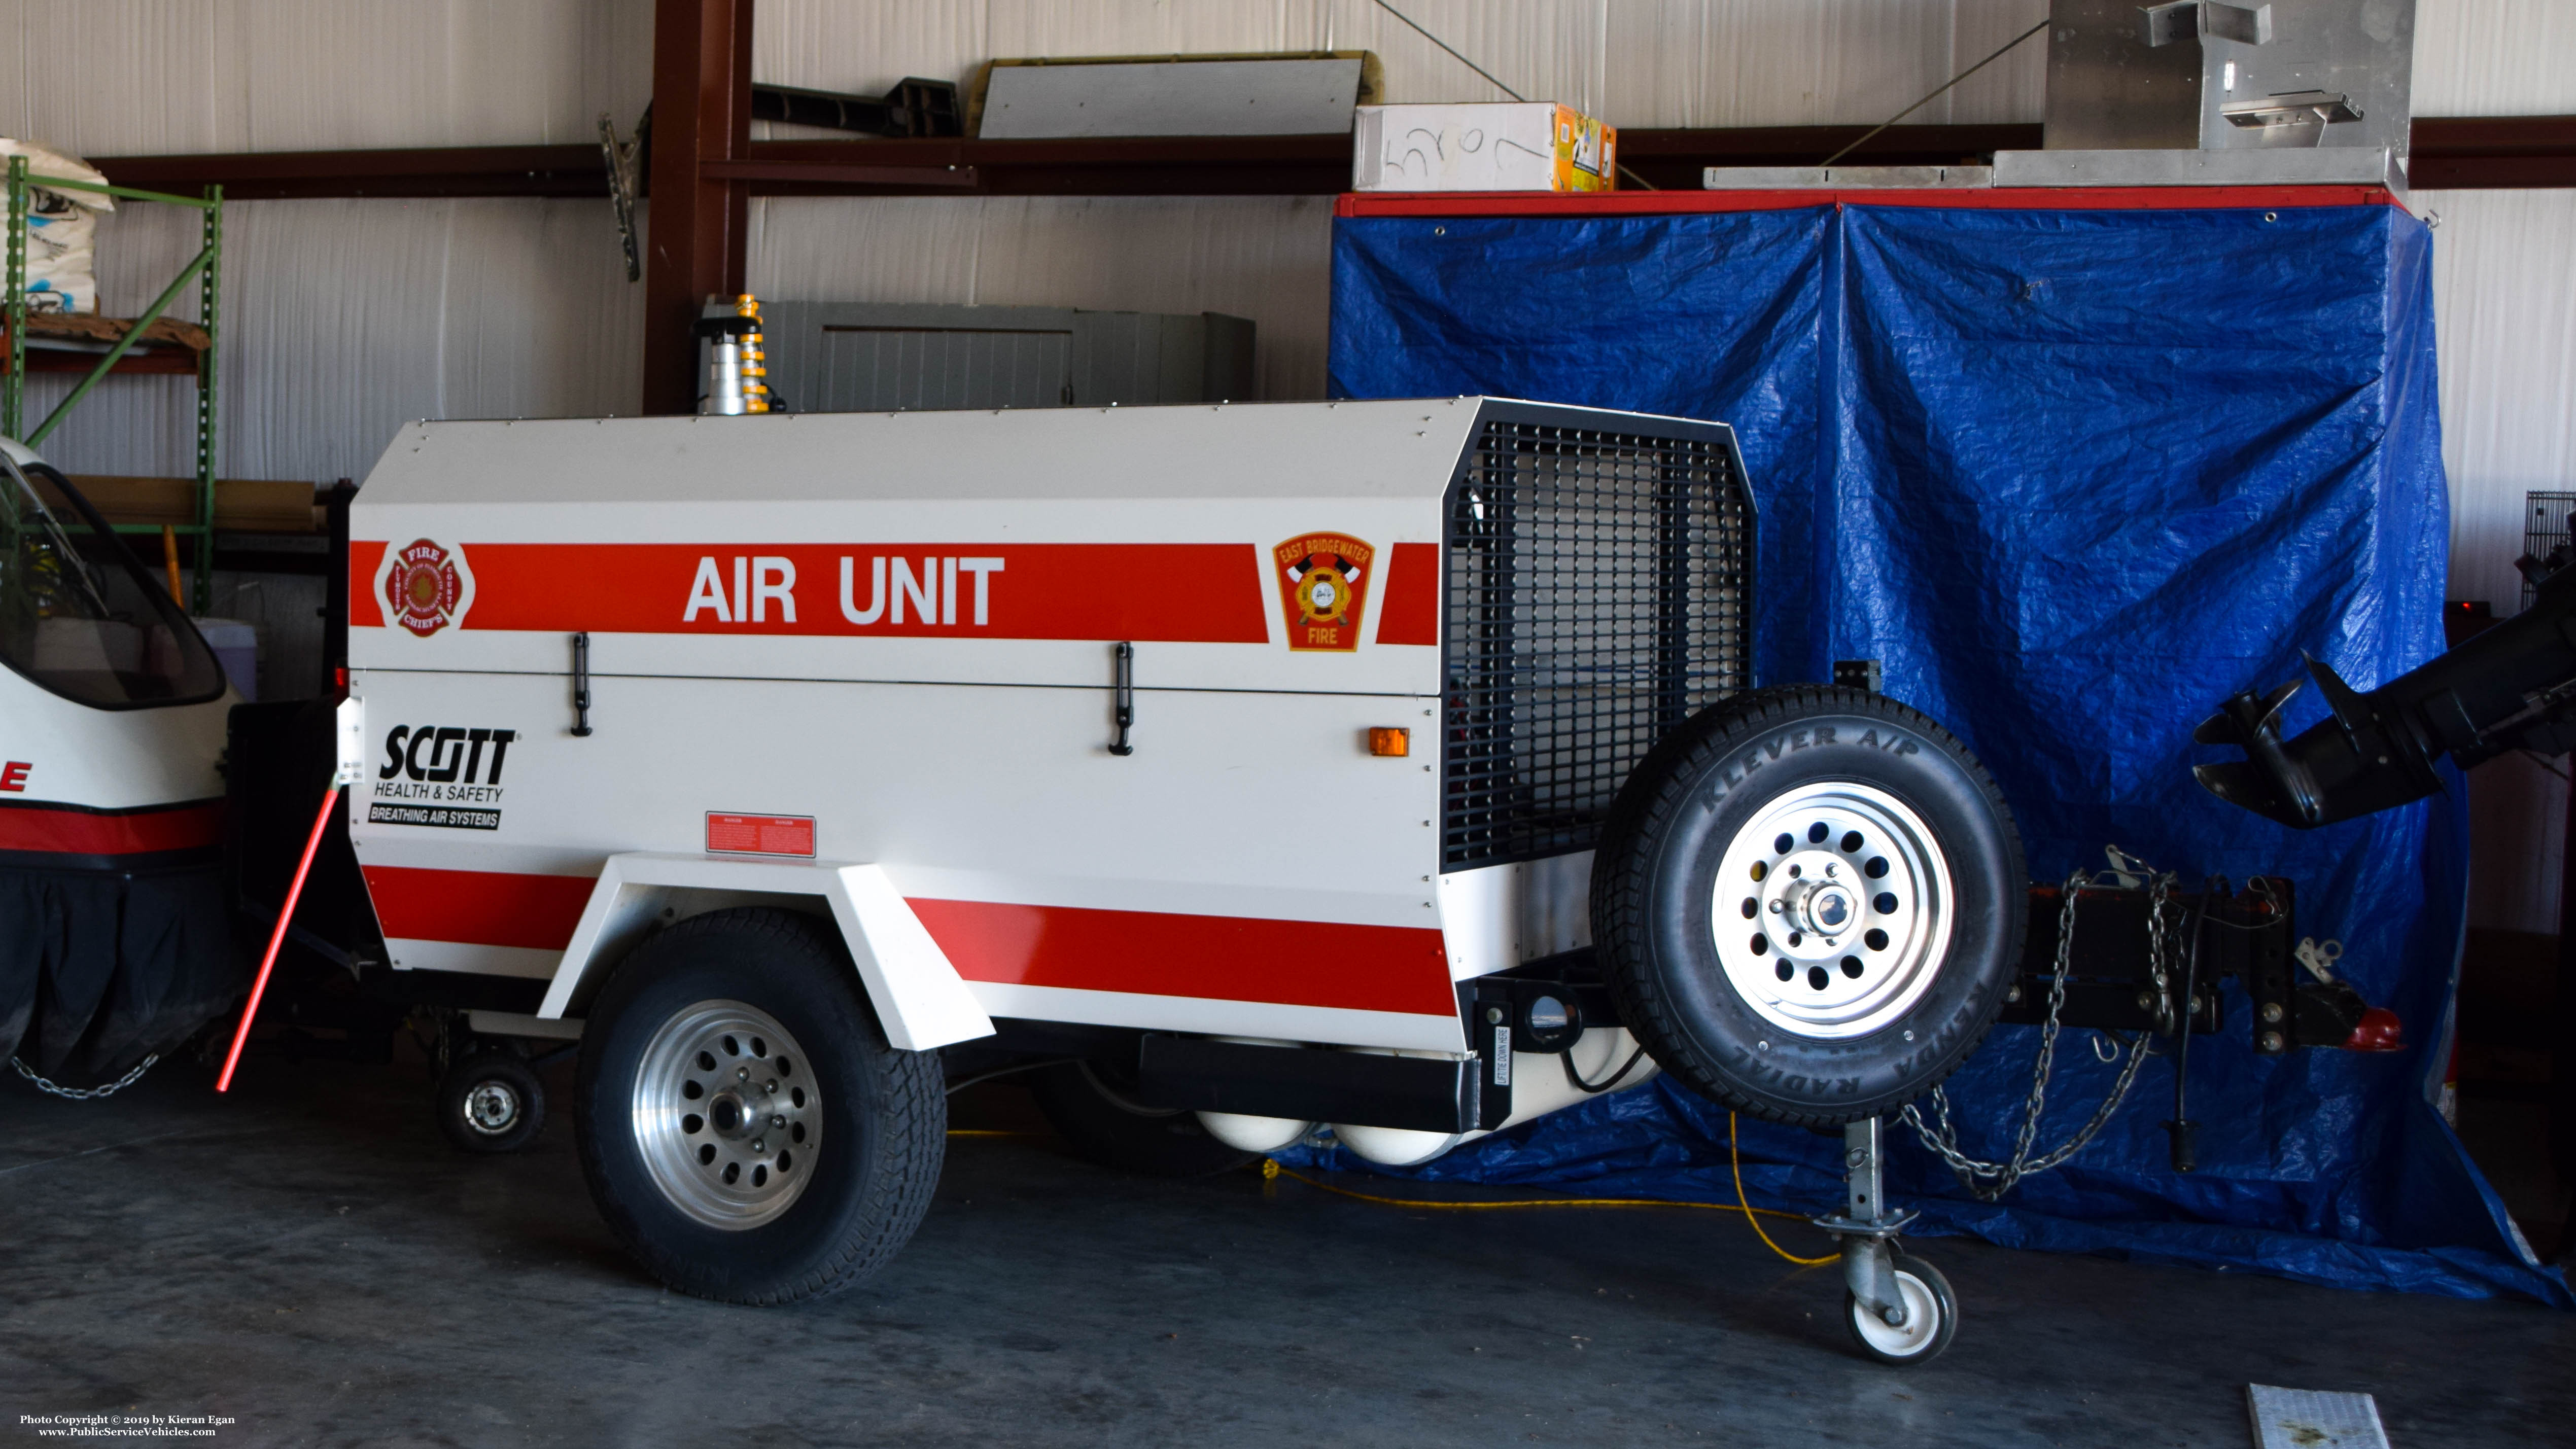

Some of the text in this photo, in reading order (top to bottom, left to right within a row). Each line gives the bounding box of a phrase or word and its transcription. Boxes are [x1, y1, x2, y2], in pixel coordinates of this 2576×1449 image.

[407, 546, 440, 562] FIRE
[1279, 538, 1370, 564] EAST BRIDGEWATER
[682, 556, 1005, 626] AIR UNIT
[404, 614, 443, 629] CHIEF'S
[1308, 627, 1338, 645] FIRE
[1699, 726, 1920, 816] KLEVER A/P
[375, 782, 503, 802] HEALTH & SAFETY
[371, 806, 498, 827] BREATHING AIR SYSTEMS
[1498, 1029, 1507, 1044] HERE
[1498, 1045, 1507, 1062] DOWN
[1731, 1045, 1861, 1095] RADIAL
